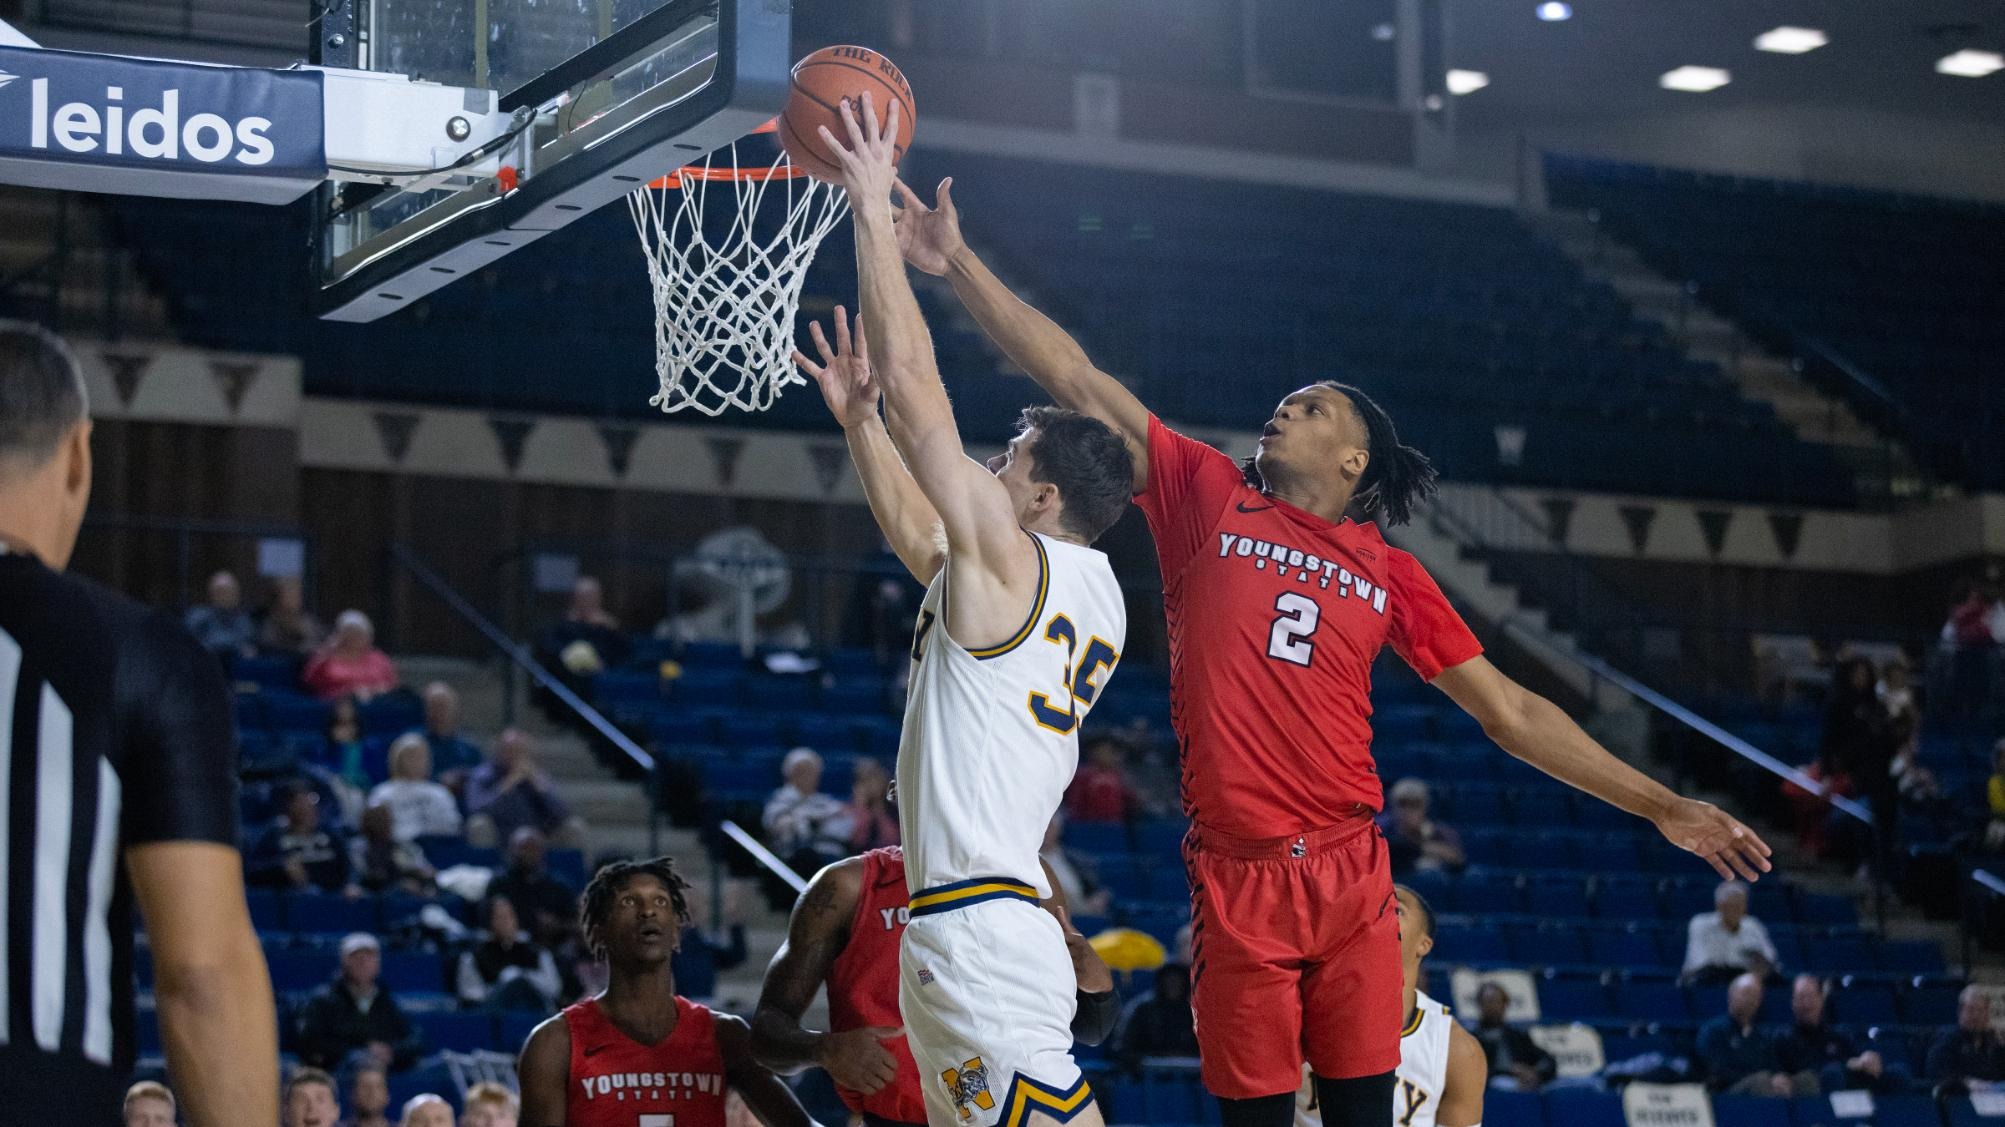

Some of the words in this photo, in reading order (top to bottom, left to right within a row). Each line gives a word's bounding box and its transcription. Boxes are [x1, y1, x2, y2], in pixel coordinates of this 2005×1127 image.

[832, 46, 871, 64] THE
[32, 77, 275, 166] leidos
[1218, 531, 1389, 617] YOUNGSTOWN
[1255, 558, 1349, 599] STATE
[1265, 590, 1322, 669] 2
[1027, 612, 1121, 736] 35
[616, 1089, 693, 1101] STATE
